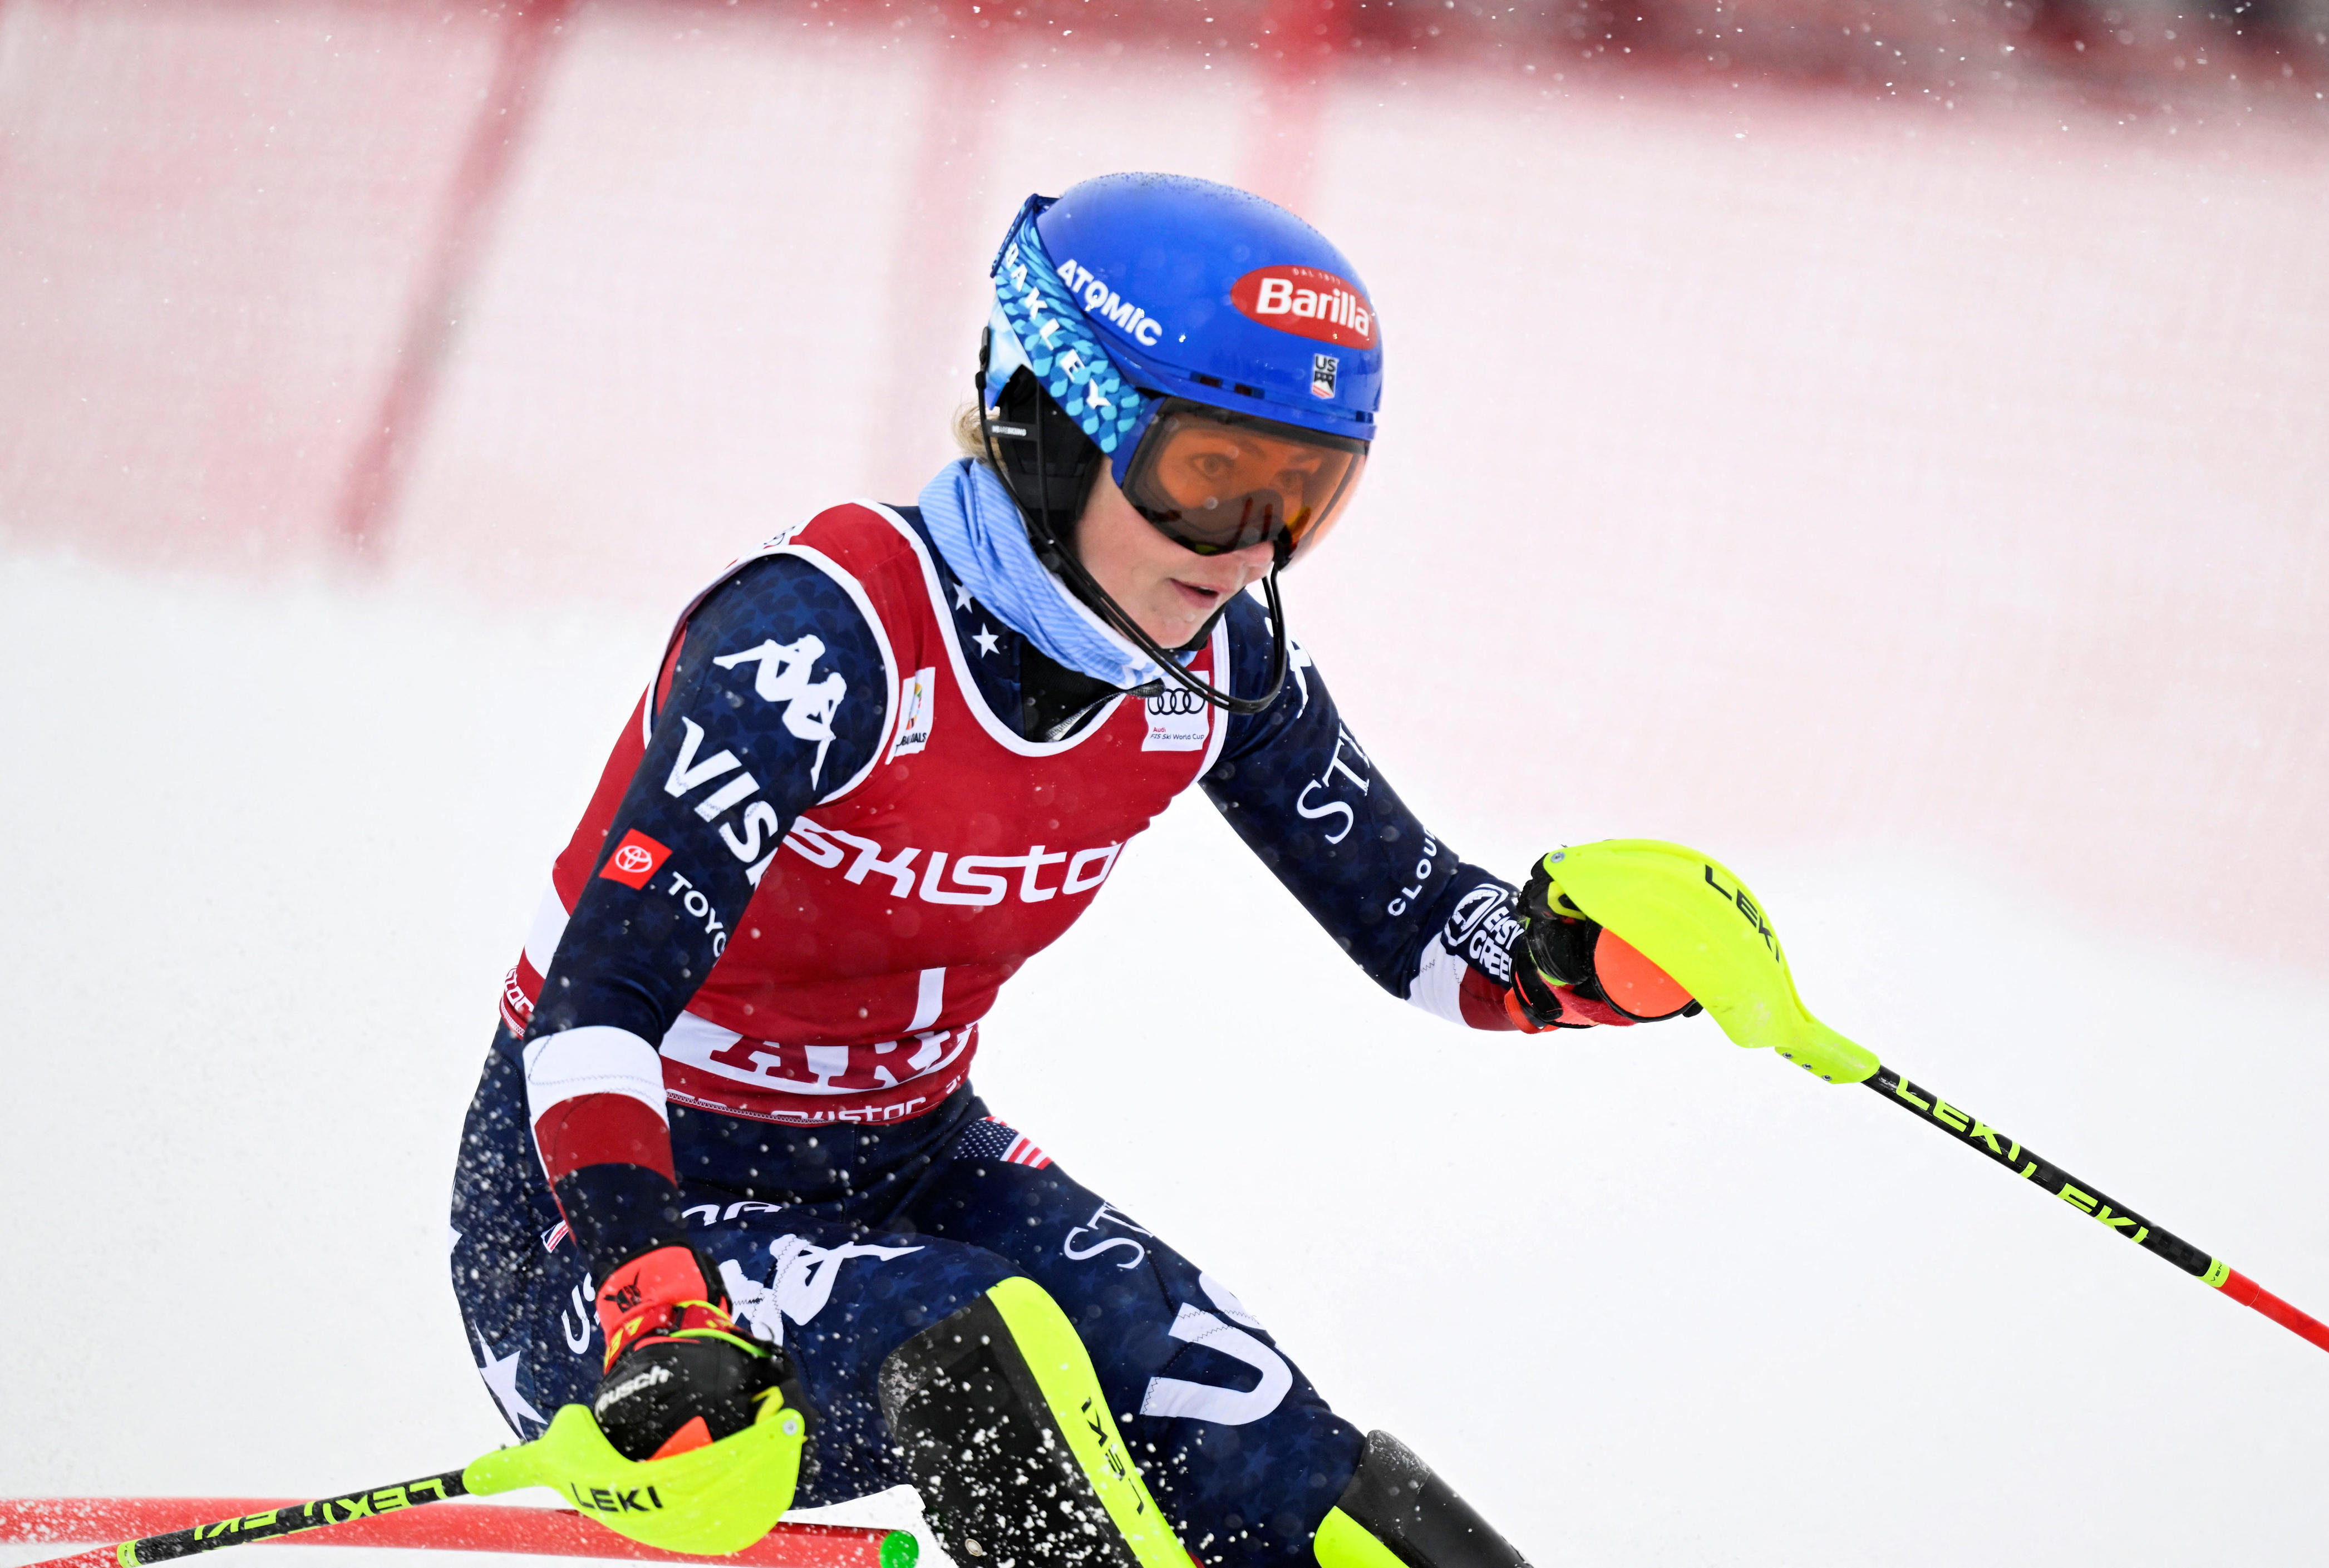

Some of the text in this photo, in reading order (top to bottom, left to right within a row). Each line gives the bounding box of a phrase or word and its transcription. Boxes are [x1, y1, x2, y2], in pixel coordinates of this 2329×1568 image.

[1005, 242, 1112, 410] OAKLEY
[1057, 258, 1163, 347] ATOMIC
[1255, 277, 1370, 337] Barilla
[1314, 355, 1337, 372] US
[668, 870, 727, 968] TOYO
[1483, 906, 1525, 951] EASY
[1705, 864, 1782, 963] LEKI
[1894, 1075, 2021, 1162] LEKI
[571, 1482, 664, 1512] LEKI
[1081, 1396, 1145, 1516] LEKI
[322, 1477, 449, 1525] LEKI
